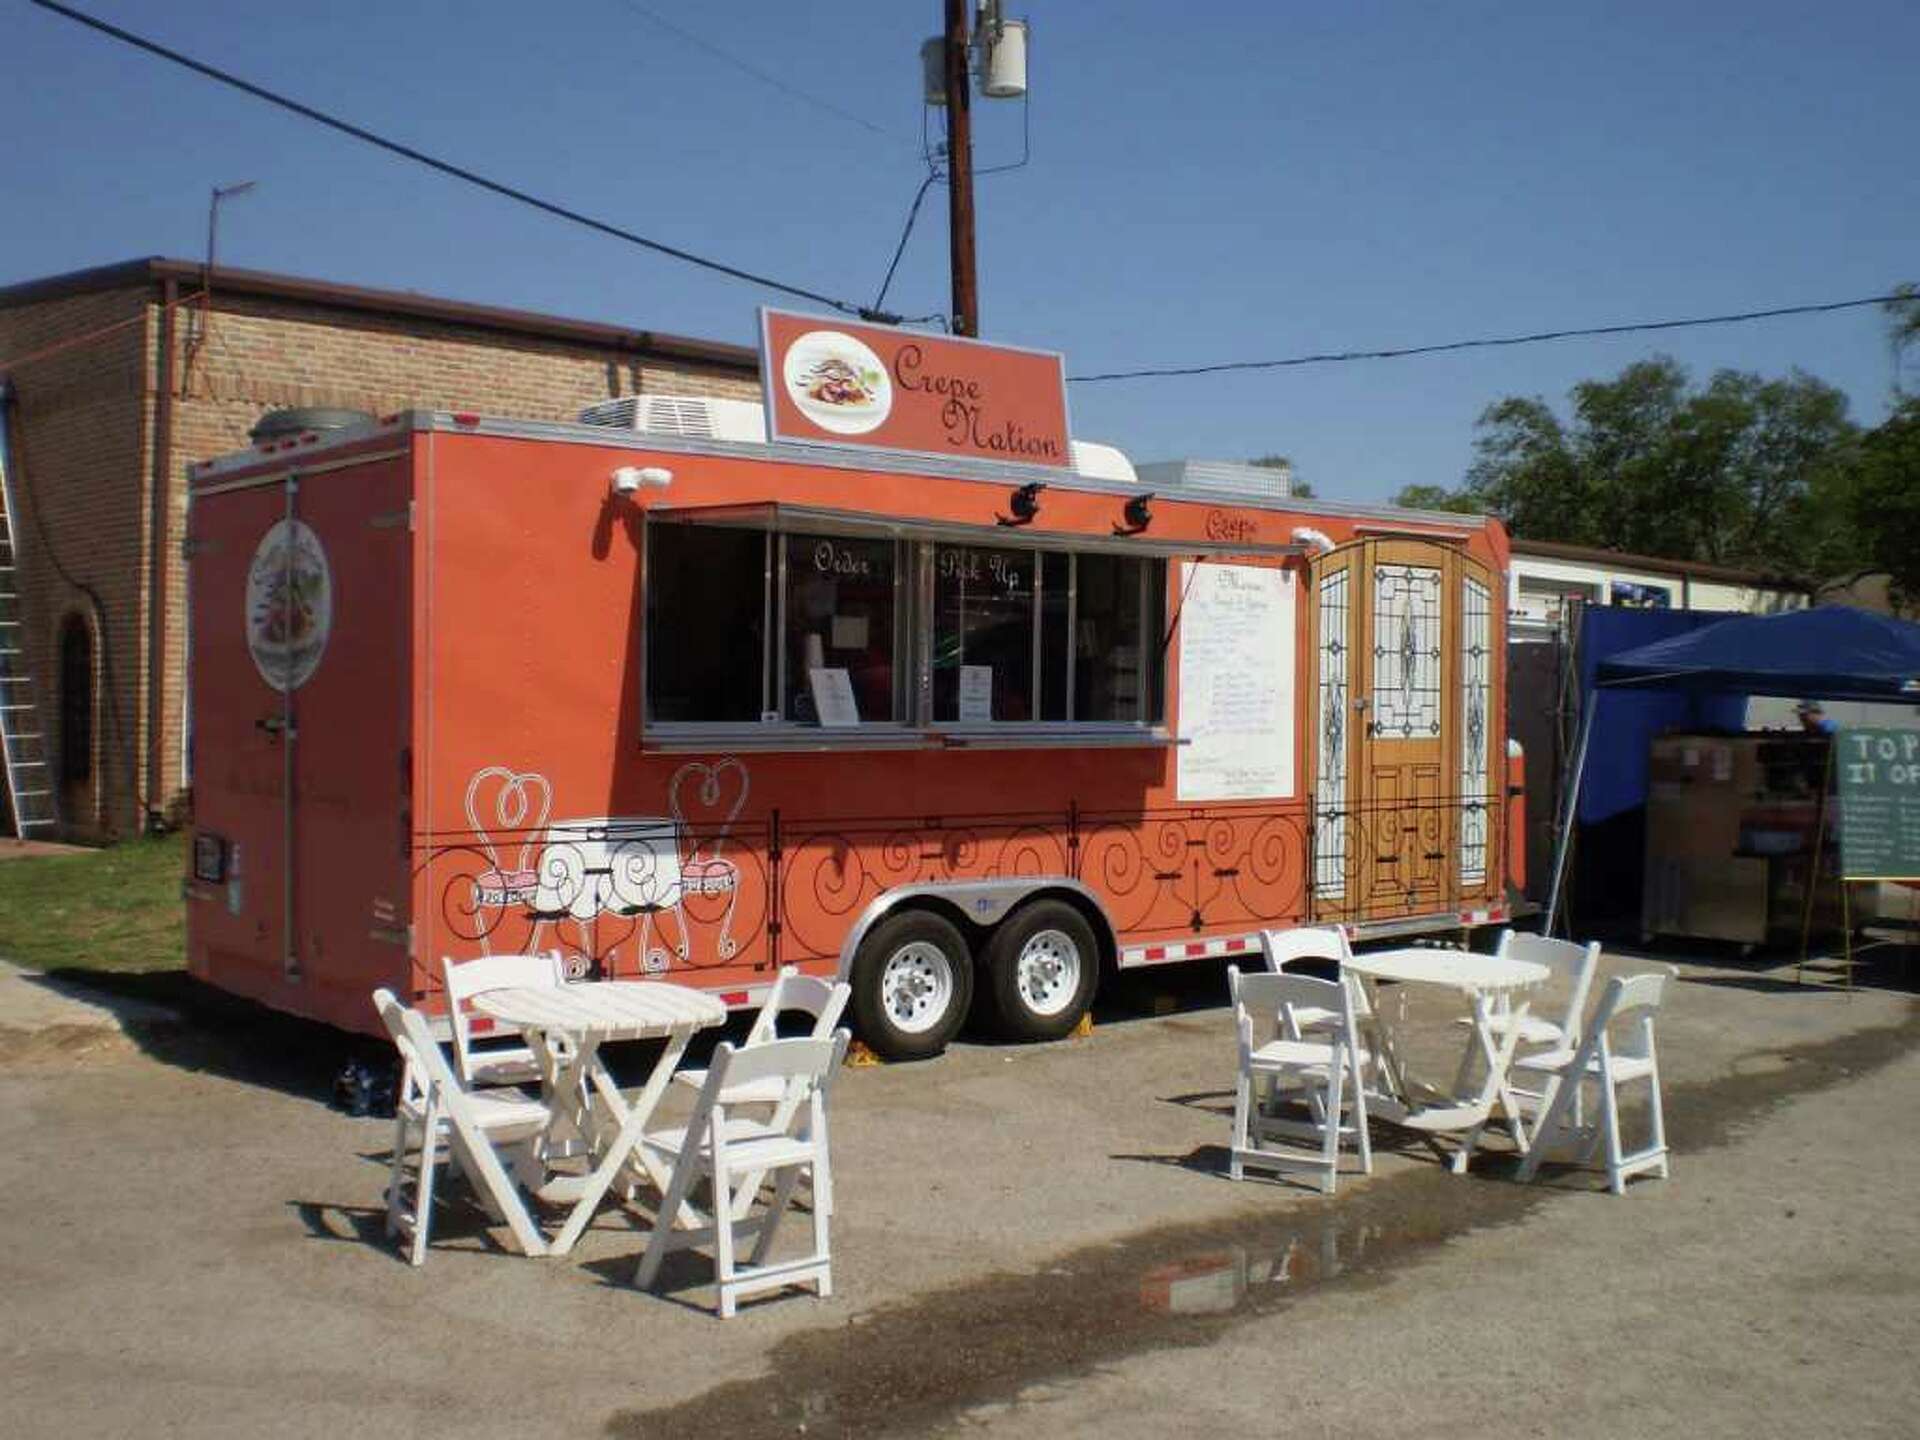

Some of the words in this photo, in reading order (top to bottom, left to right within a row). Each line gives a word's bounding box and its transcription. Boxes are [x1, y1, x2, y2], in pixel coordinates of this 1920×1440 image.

[896, 344, 981, 402] Crepe
[942, 399, 1060, 457] Nation
[814, 540, 870, 575] Order
[989, 554, 1020, 592] Up
